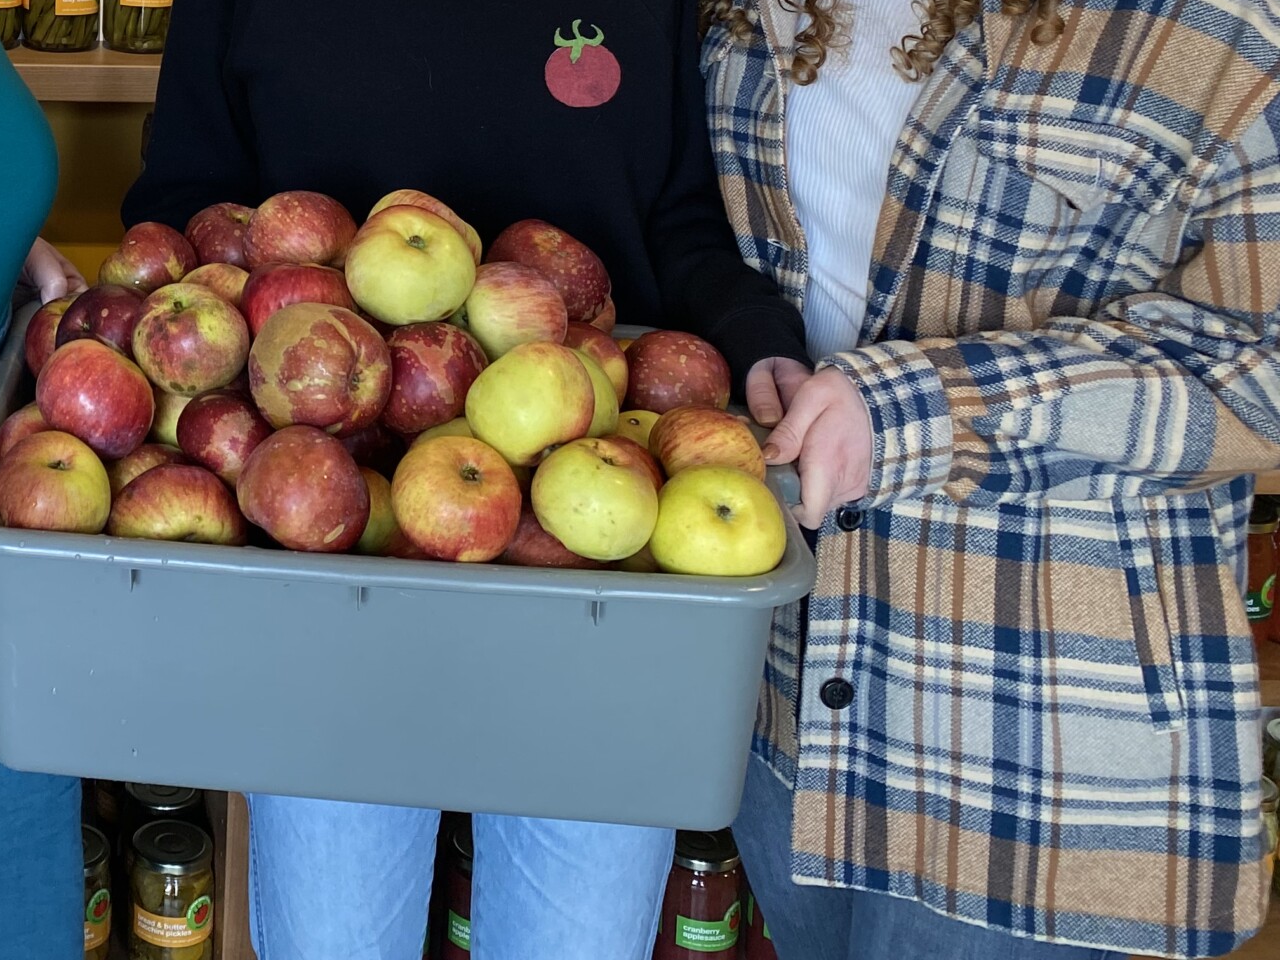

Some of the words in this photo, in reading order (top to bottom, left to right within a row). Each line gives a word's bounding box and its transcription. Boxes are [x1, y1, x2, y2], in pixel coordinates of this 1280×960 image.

[137, 913, 156, 927] bread
[163, 922, 187, 931] butter
[452, 920, 471, 934] cranb
[165, 929, 192, 938] pickles
[682, 924, 721, 936] cranberry
[682, 930, 726, 942] applesauce
